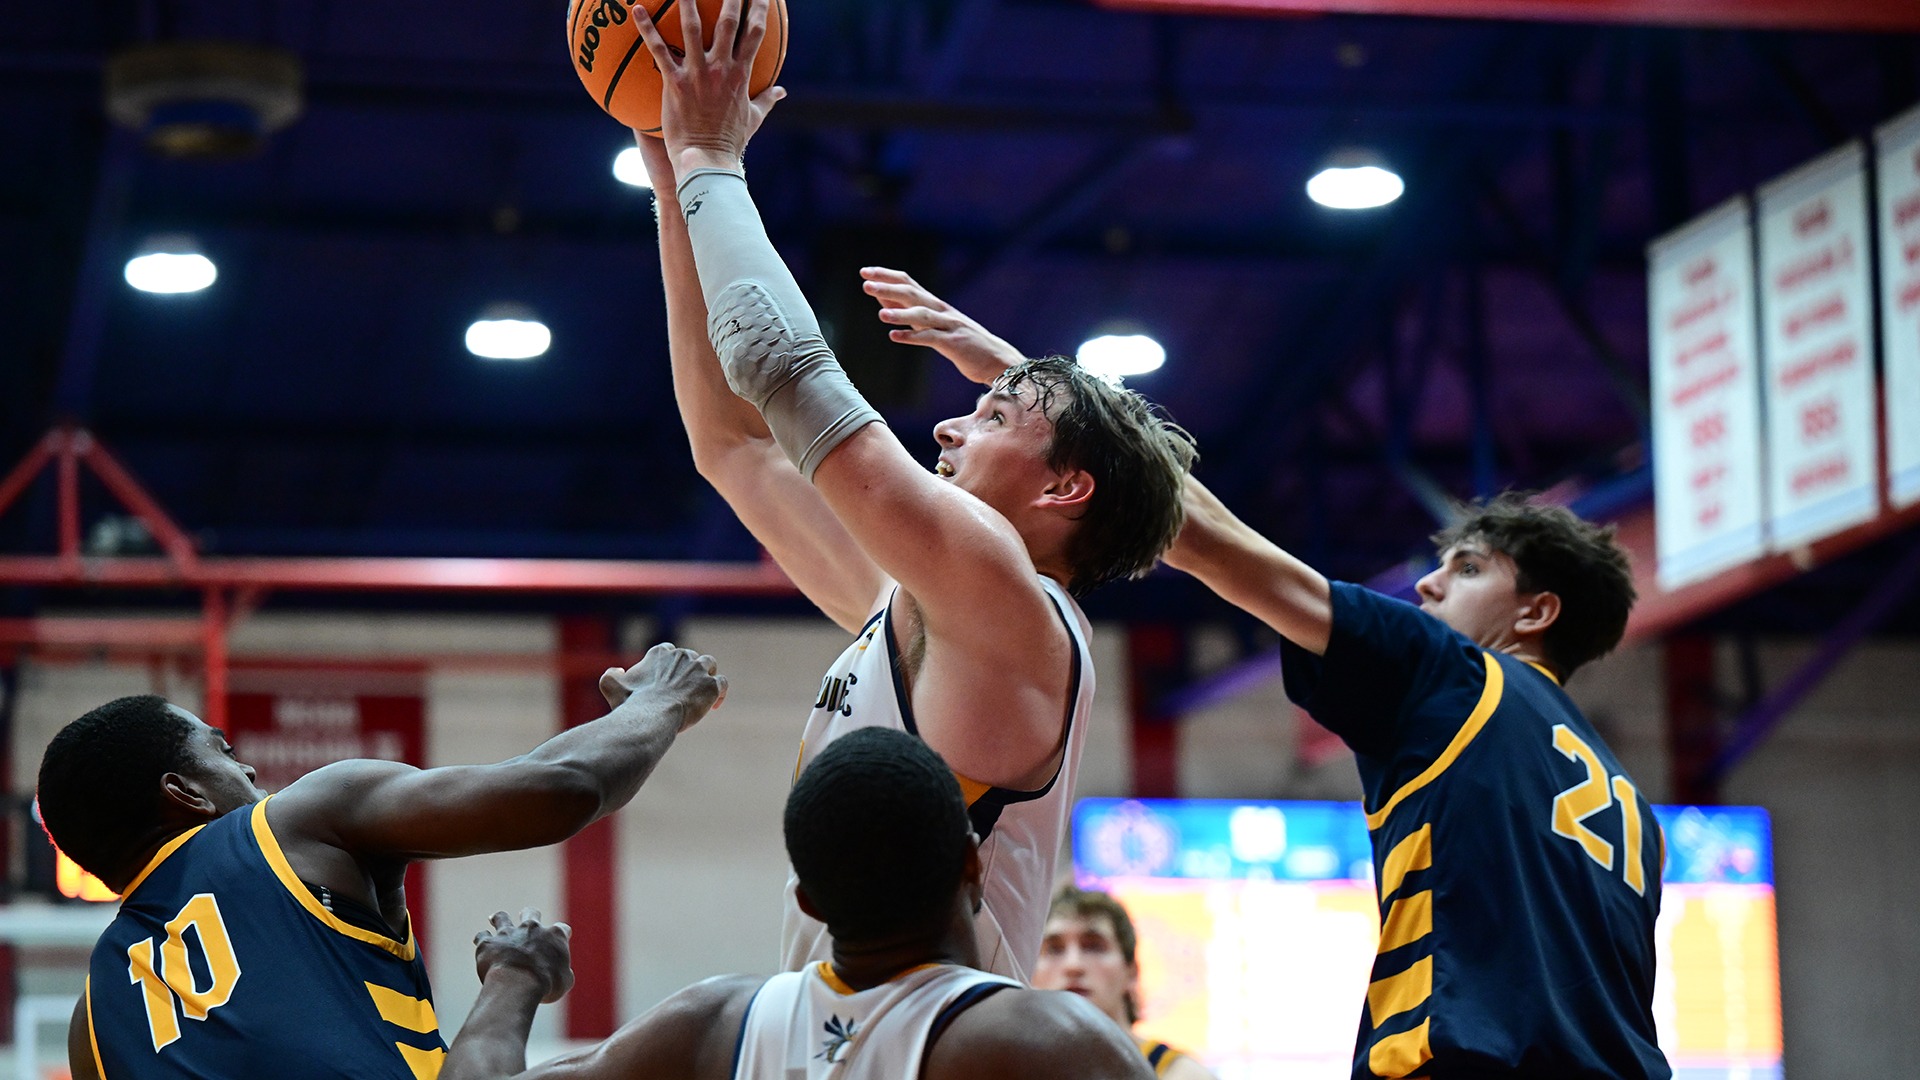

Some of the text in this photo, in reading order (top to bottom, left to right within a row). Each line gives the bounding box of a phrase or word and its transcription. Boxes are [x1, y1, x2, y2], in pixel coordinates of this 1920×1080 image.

[578, 0, 636, 74] lson
[1551, 723, 1646, 899] 21
[127, 892, 242, 1054] 10
